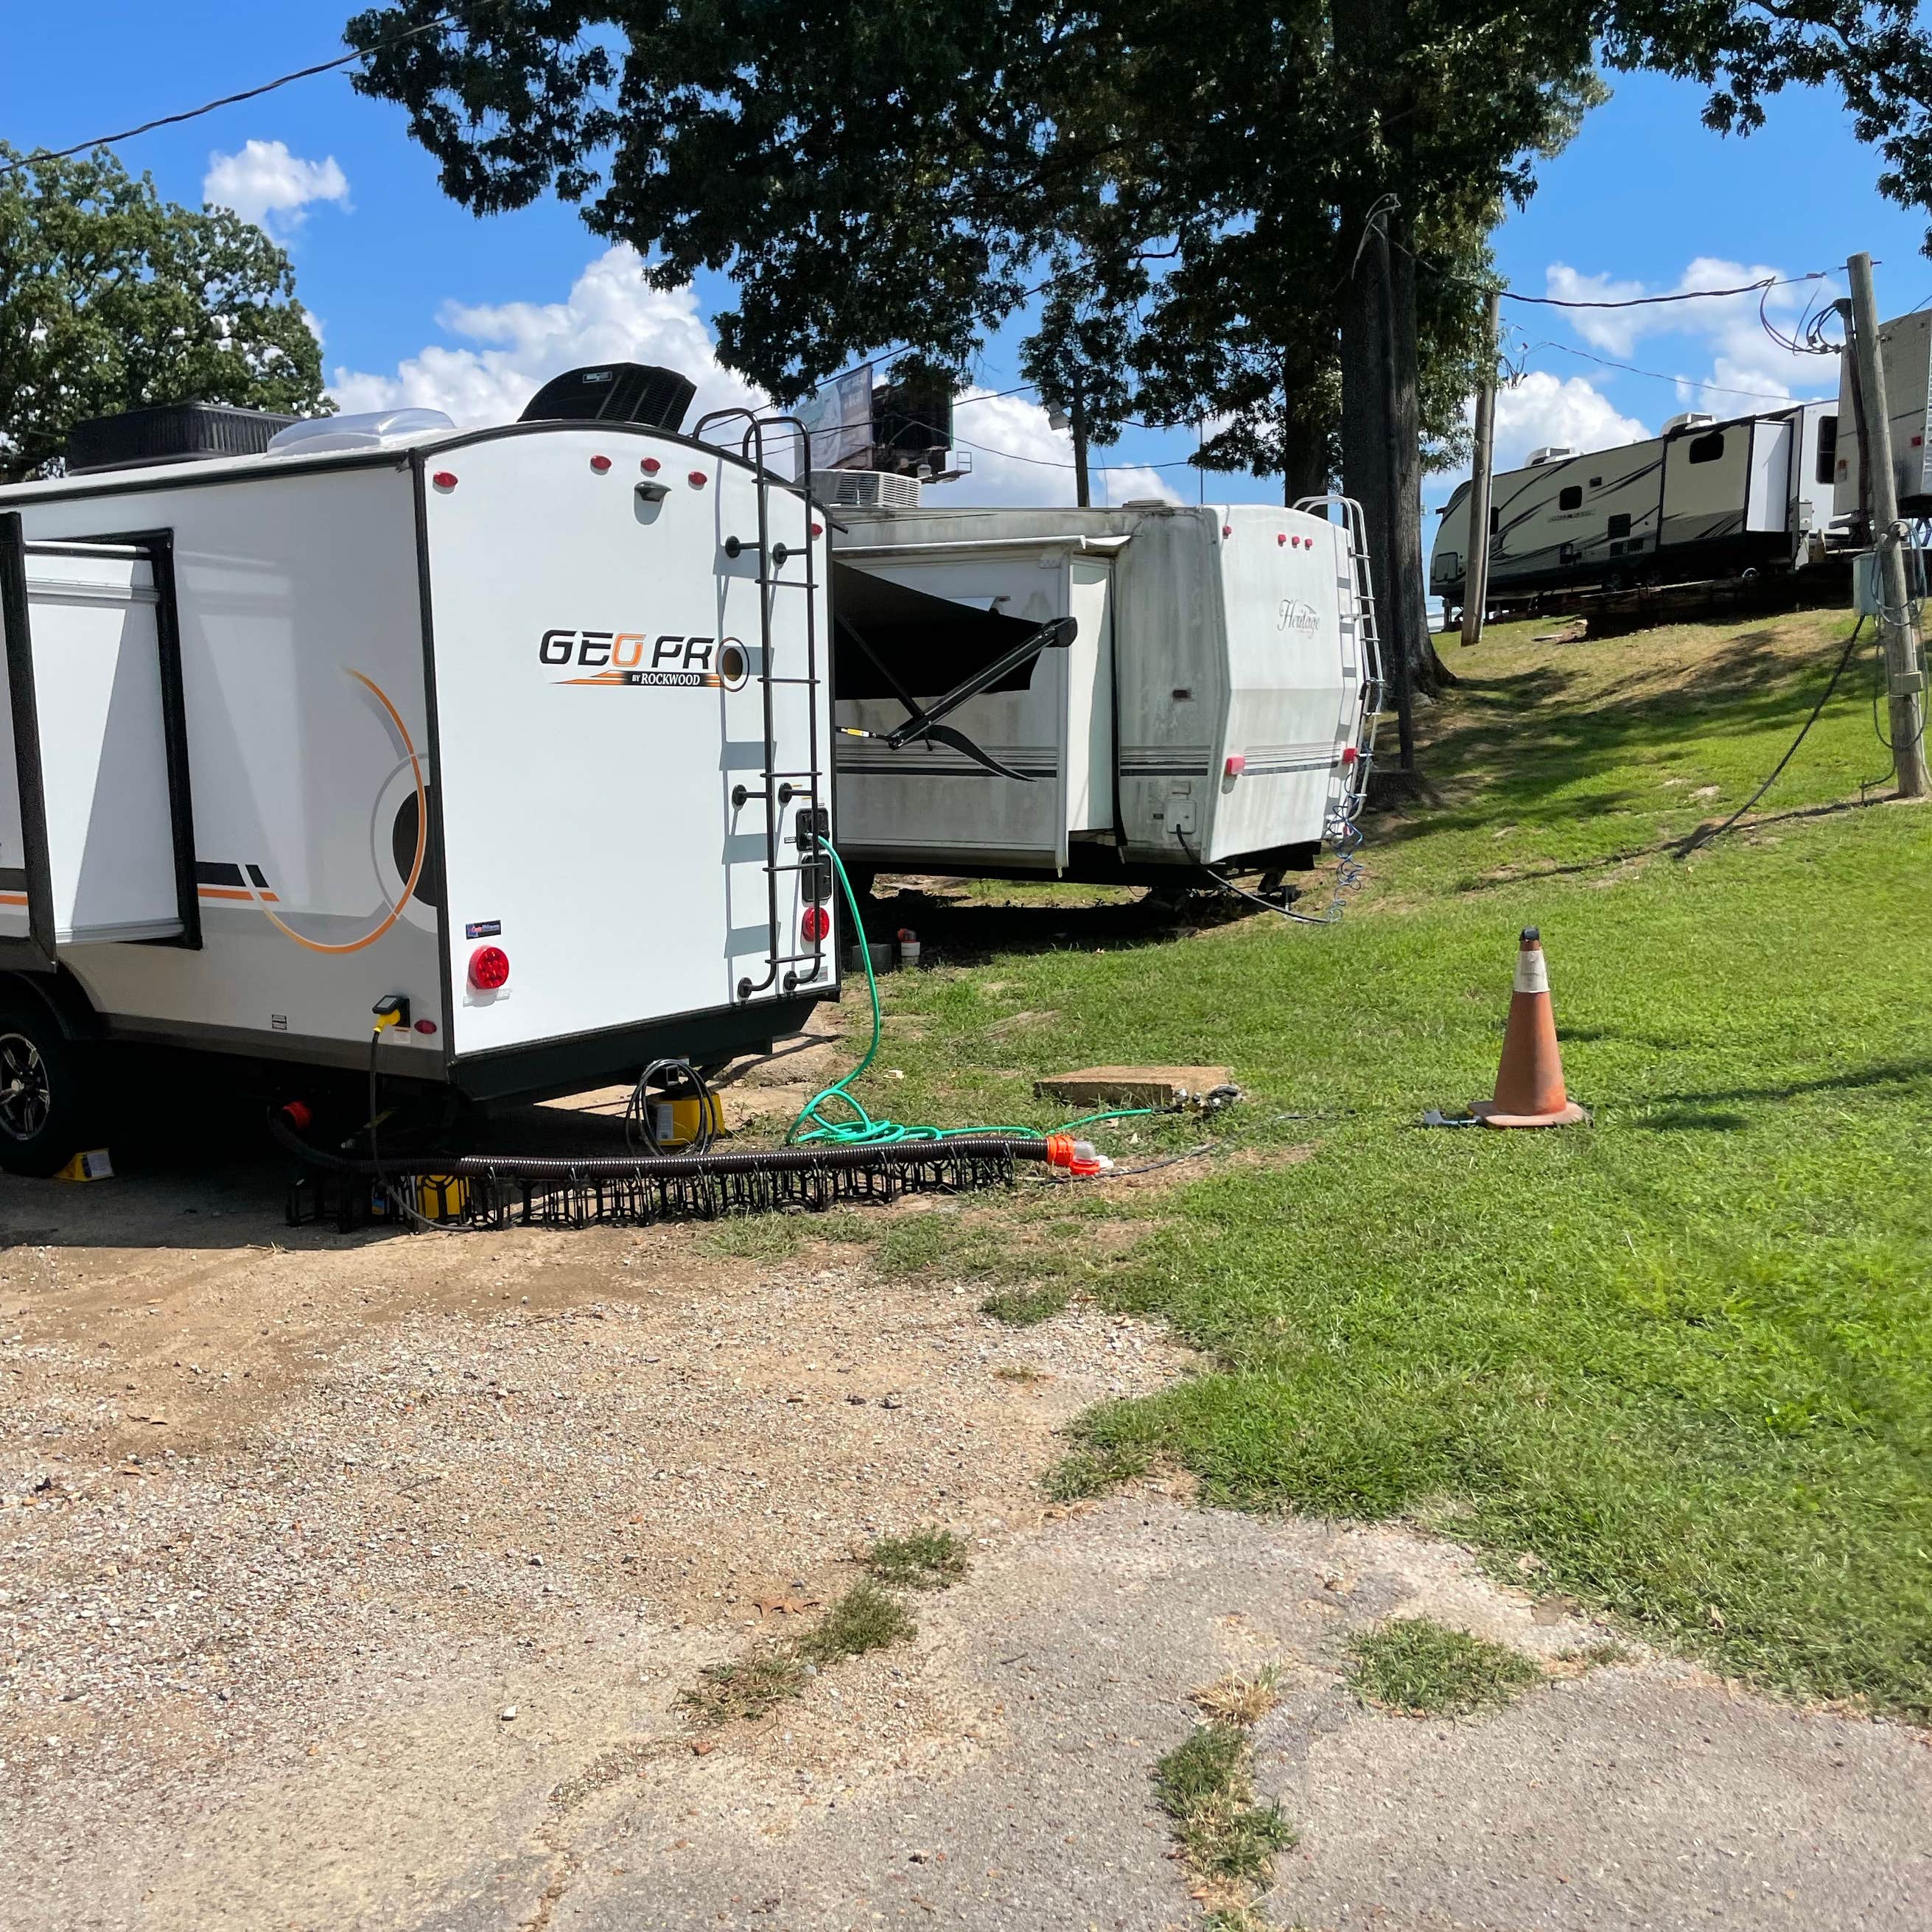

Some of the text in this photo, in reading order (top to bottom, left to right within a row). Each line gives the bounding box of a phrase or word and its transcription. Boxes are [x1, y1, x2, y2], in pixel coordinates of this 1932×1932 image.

[1277, 599, 1320, 639] Heritage
[539, 629, 646, 667] GEO
[640, 673, 701, 685] ROCKWOOD
